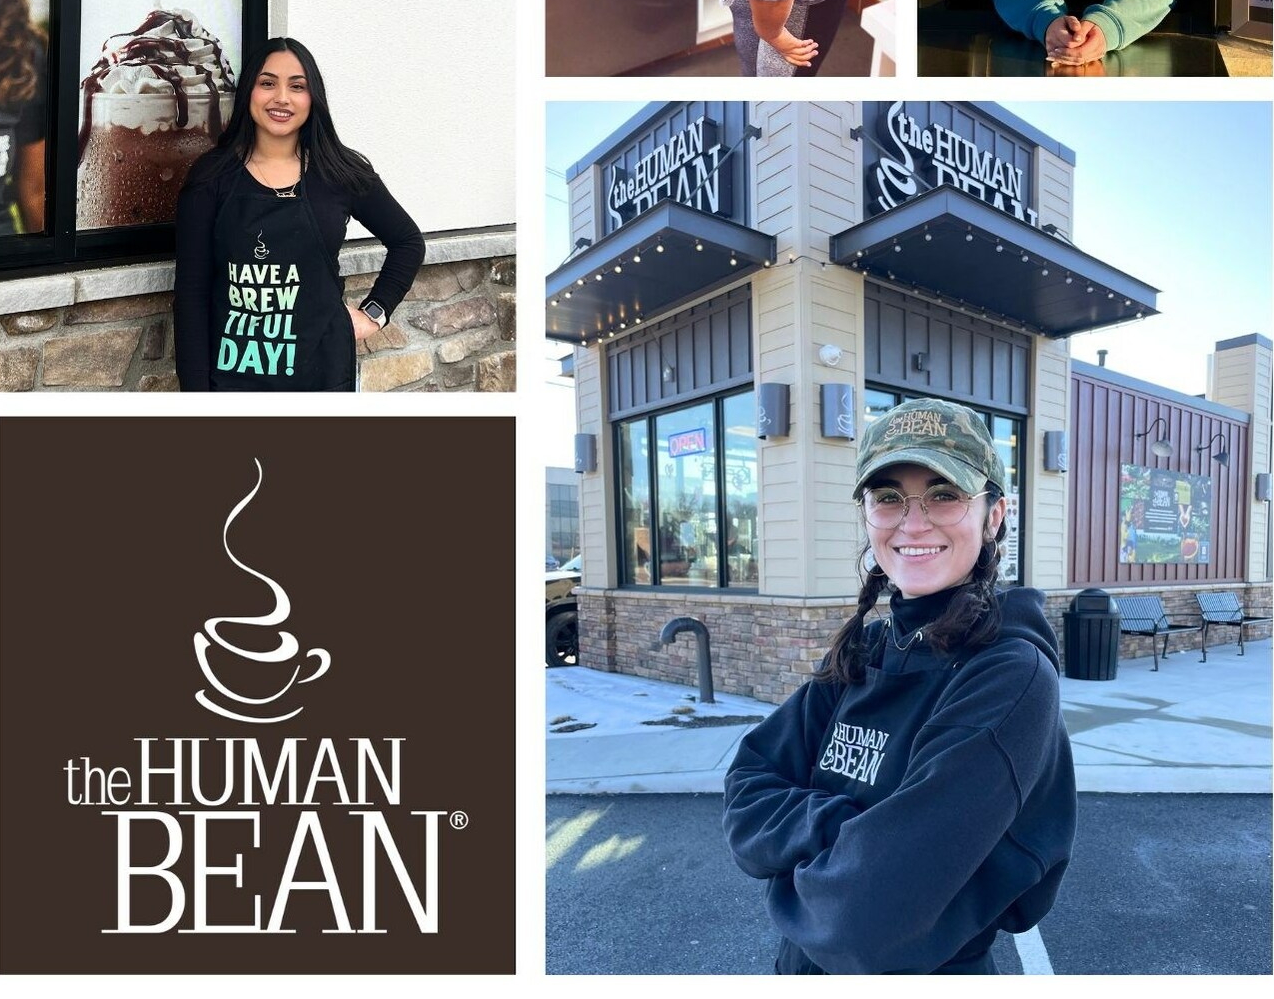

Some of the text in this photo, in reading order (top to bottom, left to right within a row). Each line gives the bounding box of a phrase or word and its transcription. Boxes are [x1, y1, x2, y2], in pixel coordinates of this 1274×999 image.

[613, 115, 705, 209] the HUMAN
[898, 113, 934, 154] the
[933, 123, 1024, 201] HUMAN
[228, 261, 300, 284] HAVE A
[229, 284, 300, 313] BREW
[224, 310, 298, 340] TIFUL
[217, 336, 296, 376] DAY!
[897, 420, 948, 437] BEAN
[903, 410, 942, 423] HUMAN
[670, 431, 704, 456] OPEN
[837, 721, 890, 751] HUMAN
[830, 740, 886, 786] BEAN
